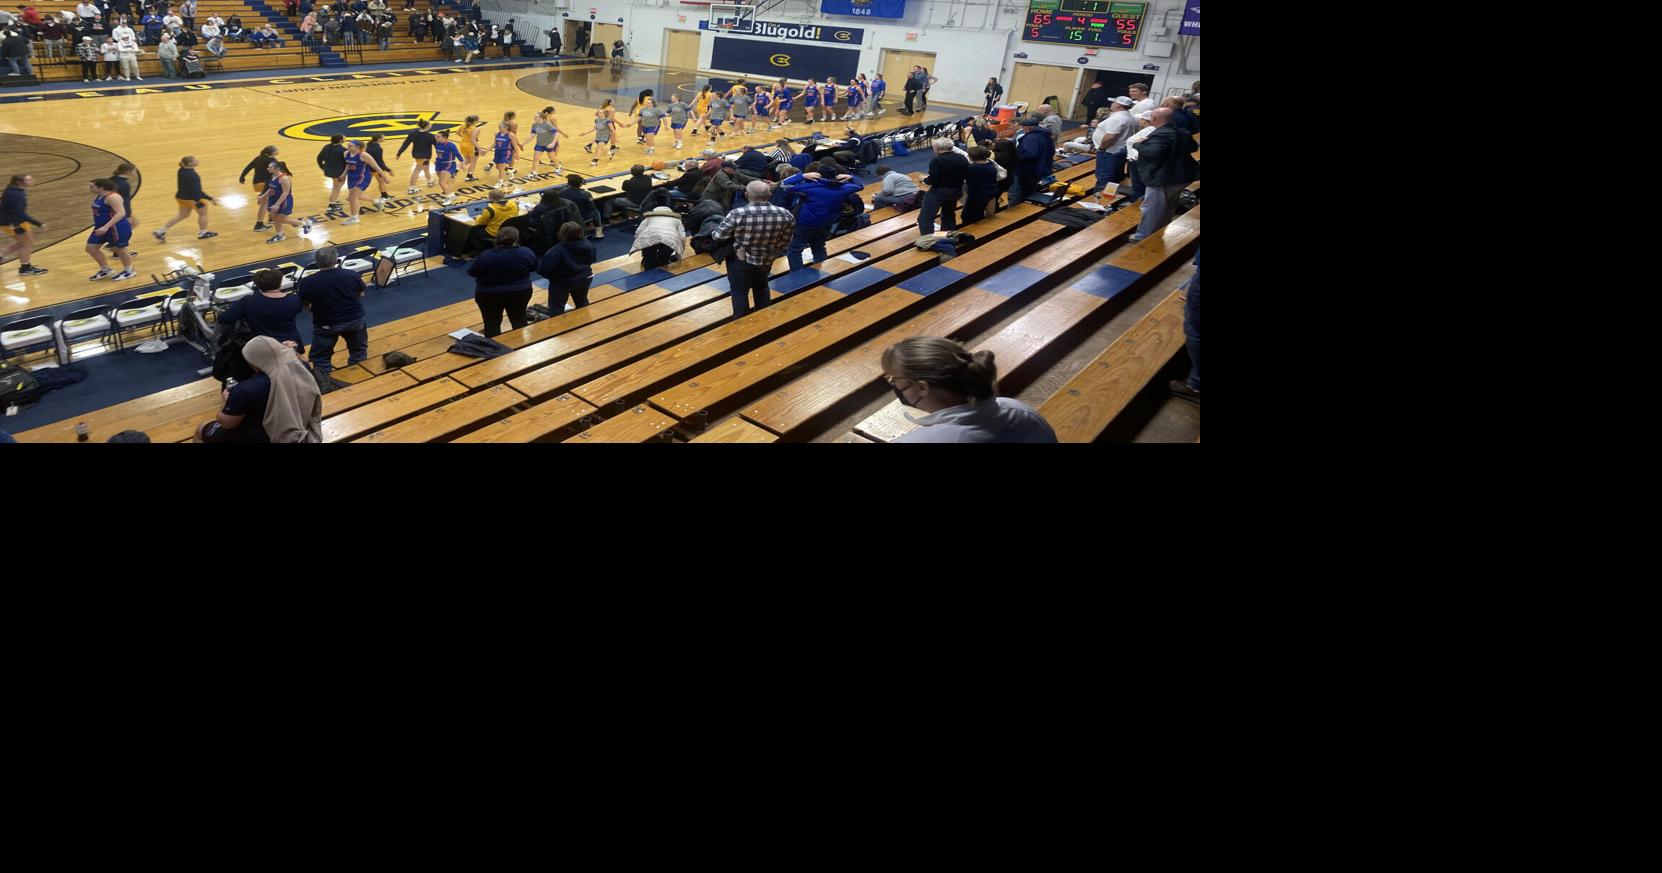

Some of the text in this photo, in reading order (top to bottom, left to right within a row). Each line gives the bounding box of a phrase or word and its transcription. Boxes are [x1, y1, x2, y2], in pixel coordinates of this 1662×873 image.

[851, 8, 872, 16] 1848
[1033, 14, 1051, 25] 65
[1077, 17, 1086, 25] 4
[1116, 19, 1136, 31] 55
[1031, 27, 1040, 38] 5
[1069, 30, 1083, 41] 15
[1122, 34, 1132, 45] 5
